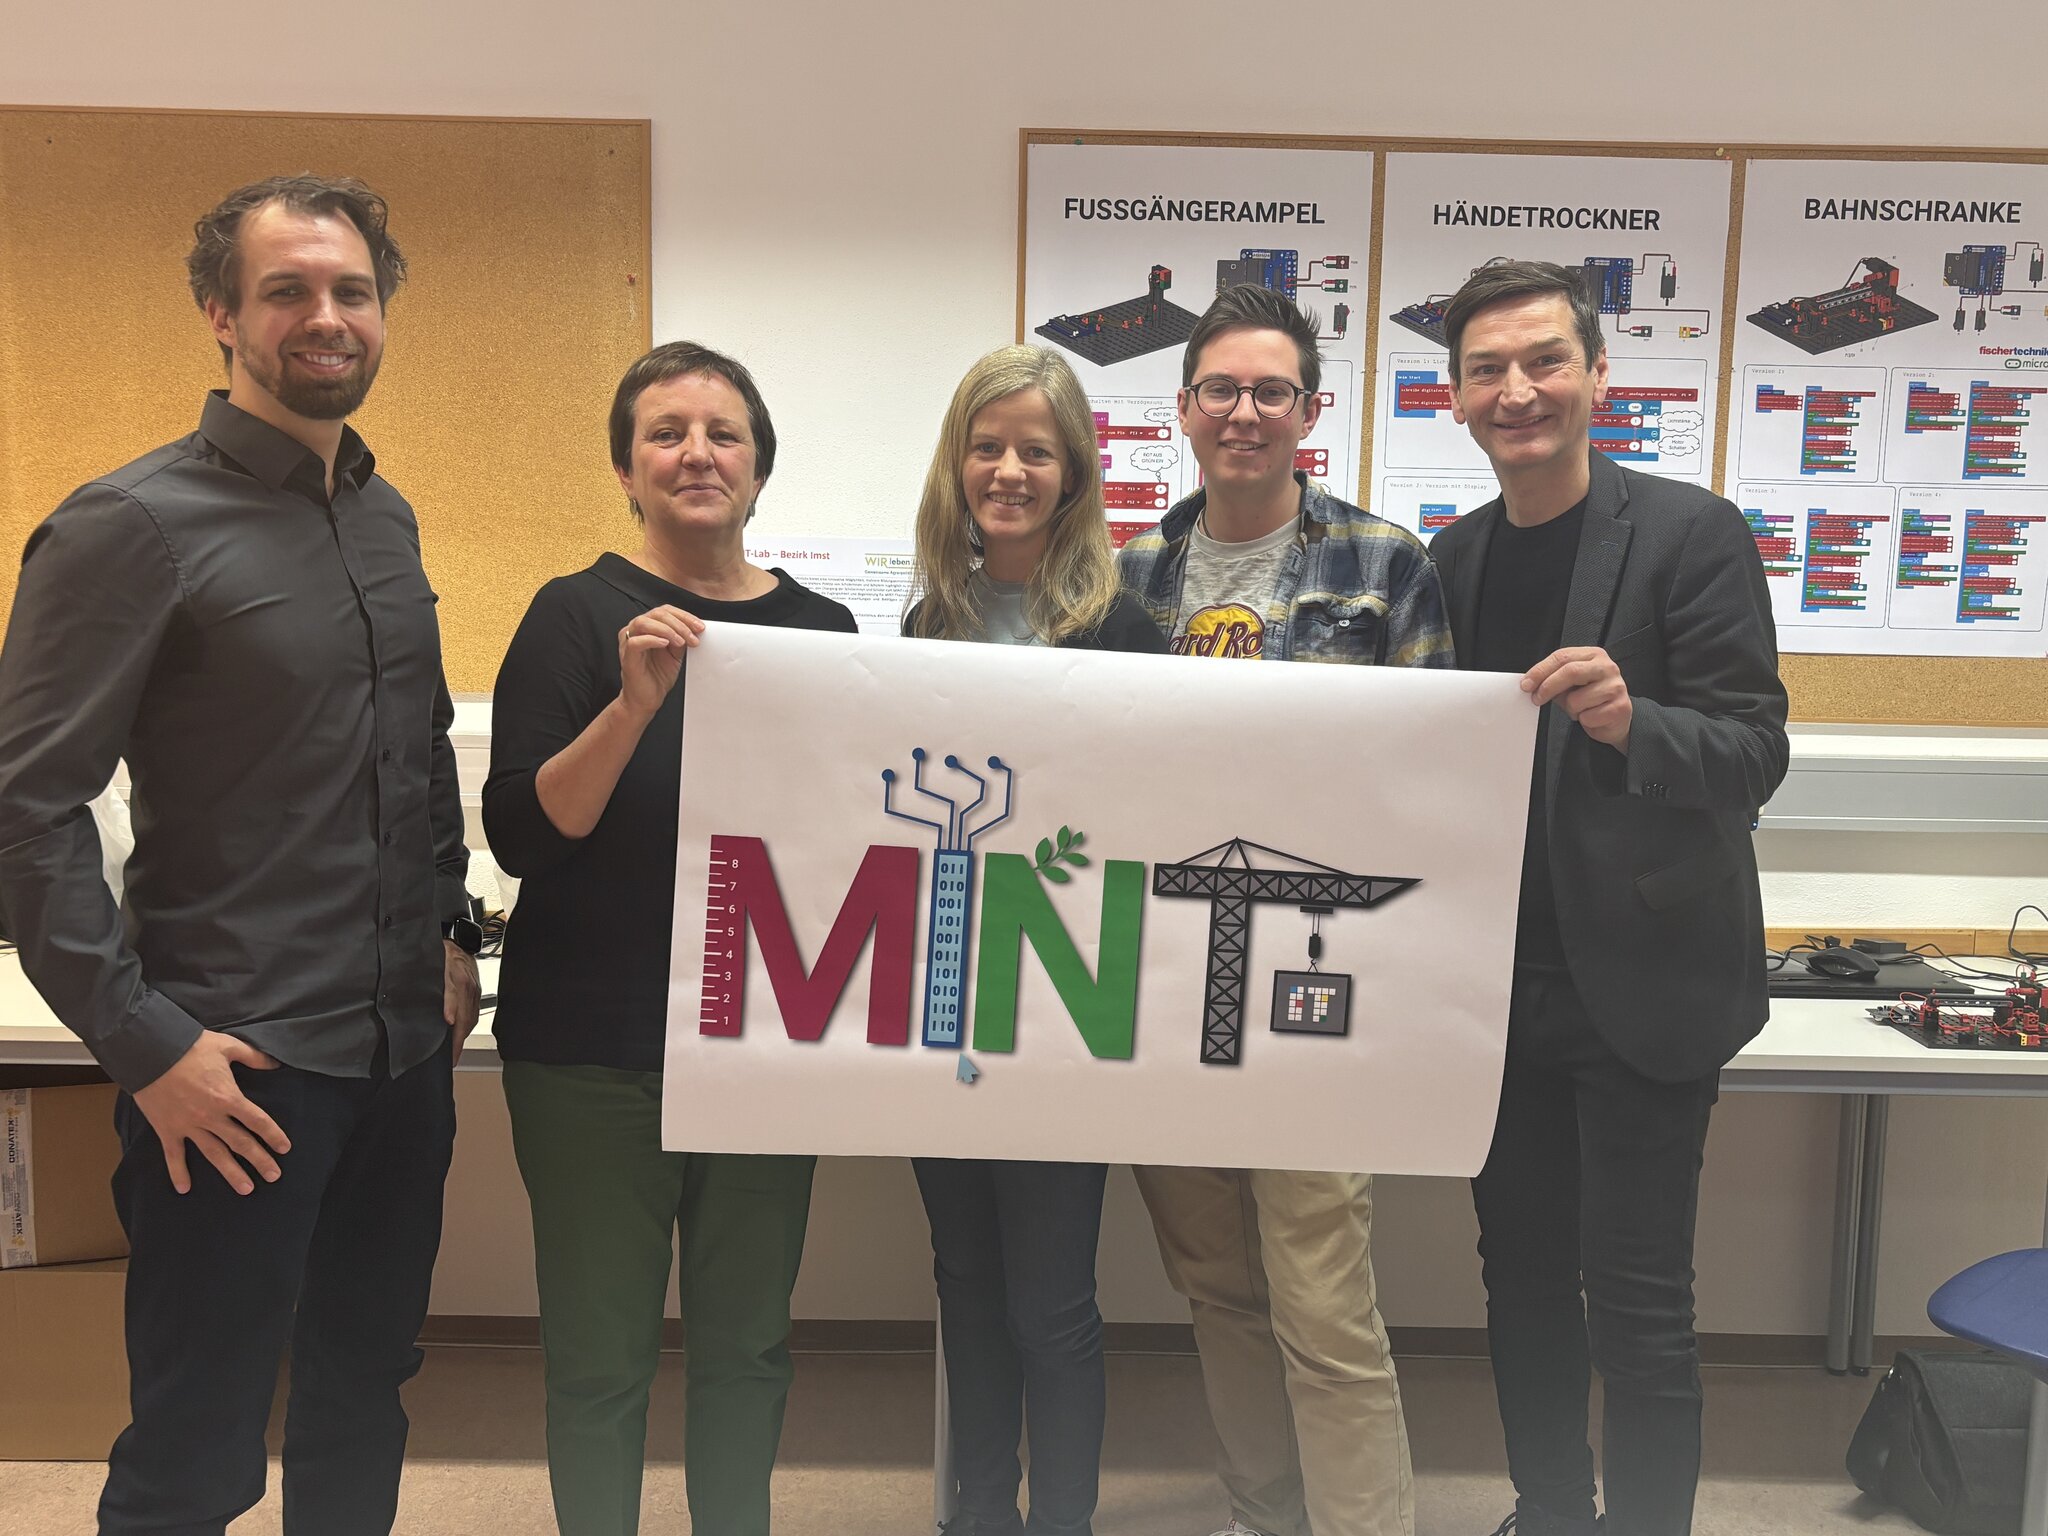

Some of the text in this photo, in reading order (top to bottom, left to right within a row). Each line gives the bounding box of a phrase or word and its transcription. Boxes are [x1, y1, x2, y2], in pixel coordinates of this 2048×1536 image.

[1064, 195, 1325, 224] FUSSGÄNGERAMPEL
[1804, 198, 2022, 223] BAHNSCHRANKE
[1433, 200, 1660, 231] HÄNDETROCKNER
[1464, 483, 1488, 491] Display
[745, 549, 770, 558] T-Lab
[780, 550, 808, 559] Bezirk
[810, 551, 830, 560] Imst
[864, 556, 888, 568] WIR
[889, 557, 911, 566] leben
[1168, 621, 1264, 658] ard Ro
[732, 859, 739, 869] 8
[941, 863, 964, 874] 011
[729, 881, 737, 891] 7
[940, 881, 965, 892] 010
[728, 904, 736, 914] 6
[938, 898, 962, 909] 001
[939, 915, 961, 927] 101
[727, 927, 735, 937] 5
[936, 933, 959, 944] 001
[699, 834, 1423, 1065] MINT
[725, 950, 733, 960] 4
[935, 950, 958, 962] 011
[724, 971, 732, 981] 3
[936, 968, 957, 979] 101
[932, 985, 958, 997] 010
[723, 993, 731, 1003] 2
[933, 1003, 957, 1015] 110
[723, 1016, 729, 1025] 1
[932, 1020, 956, 1032] 110
[8, 1119, 16, 1164] CONATEX
